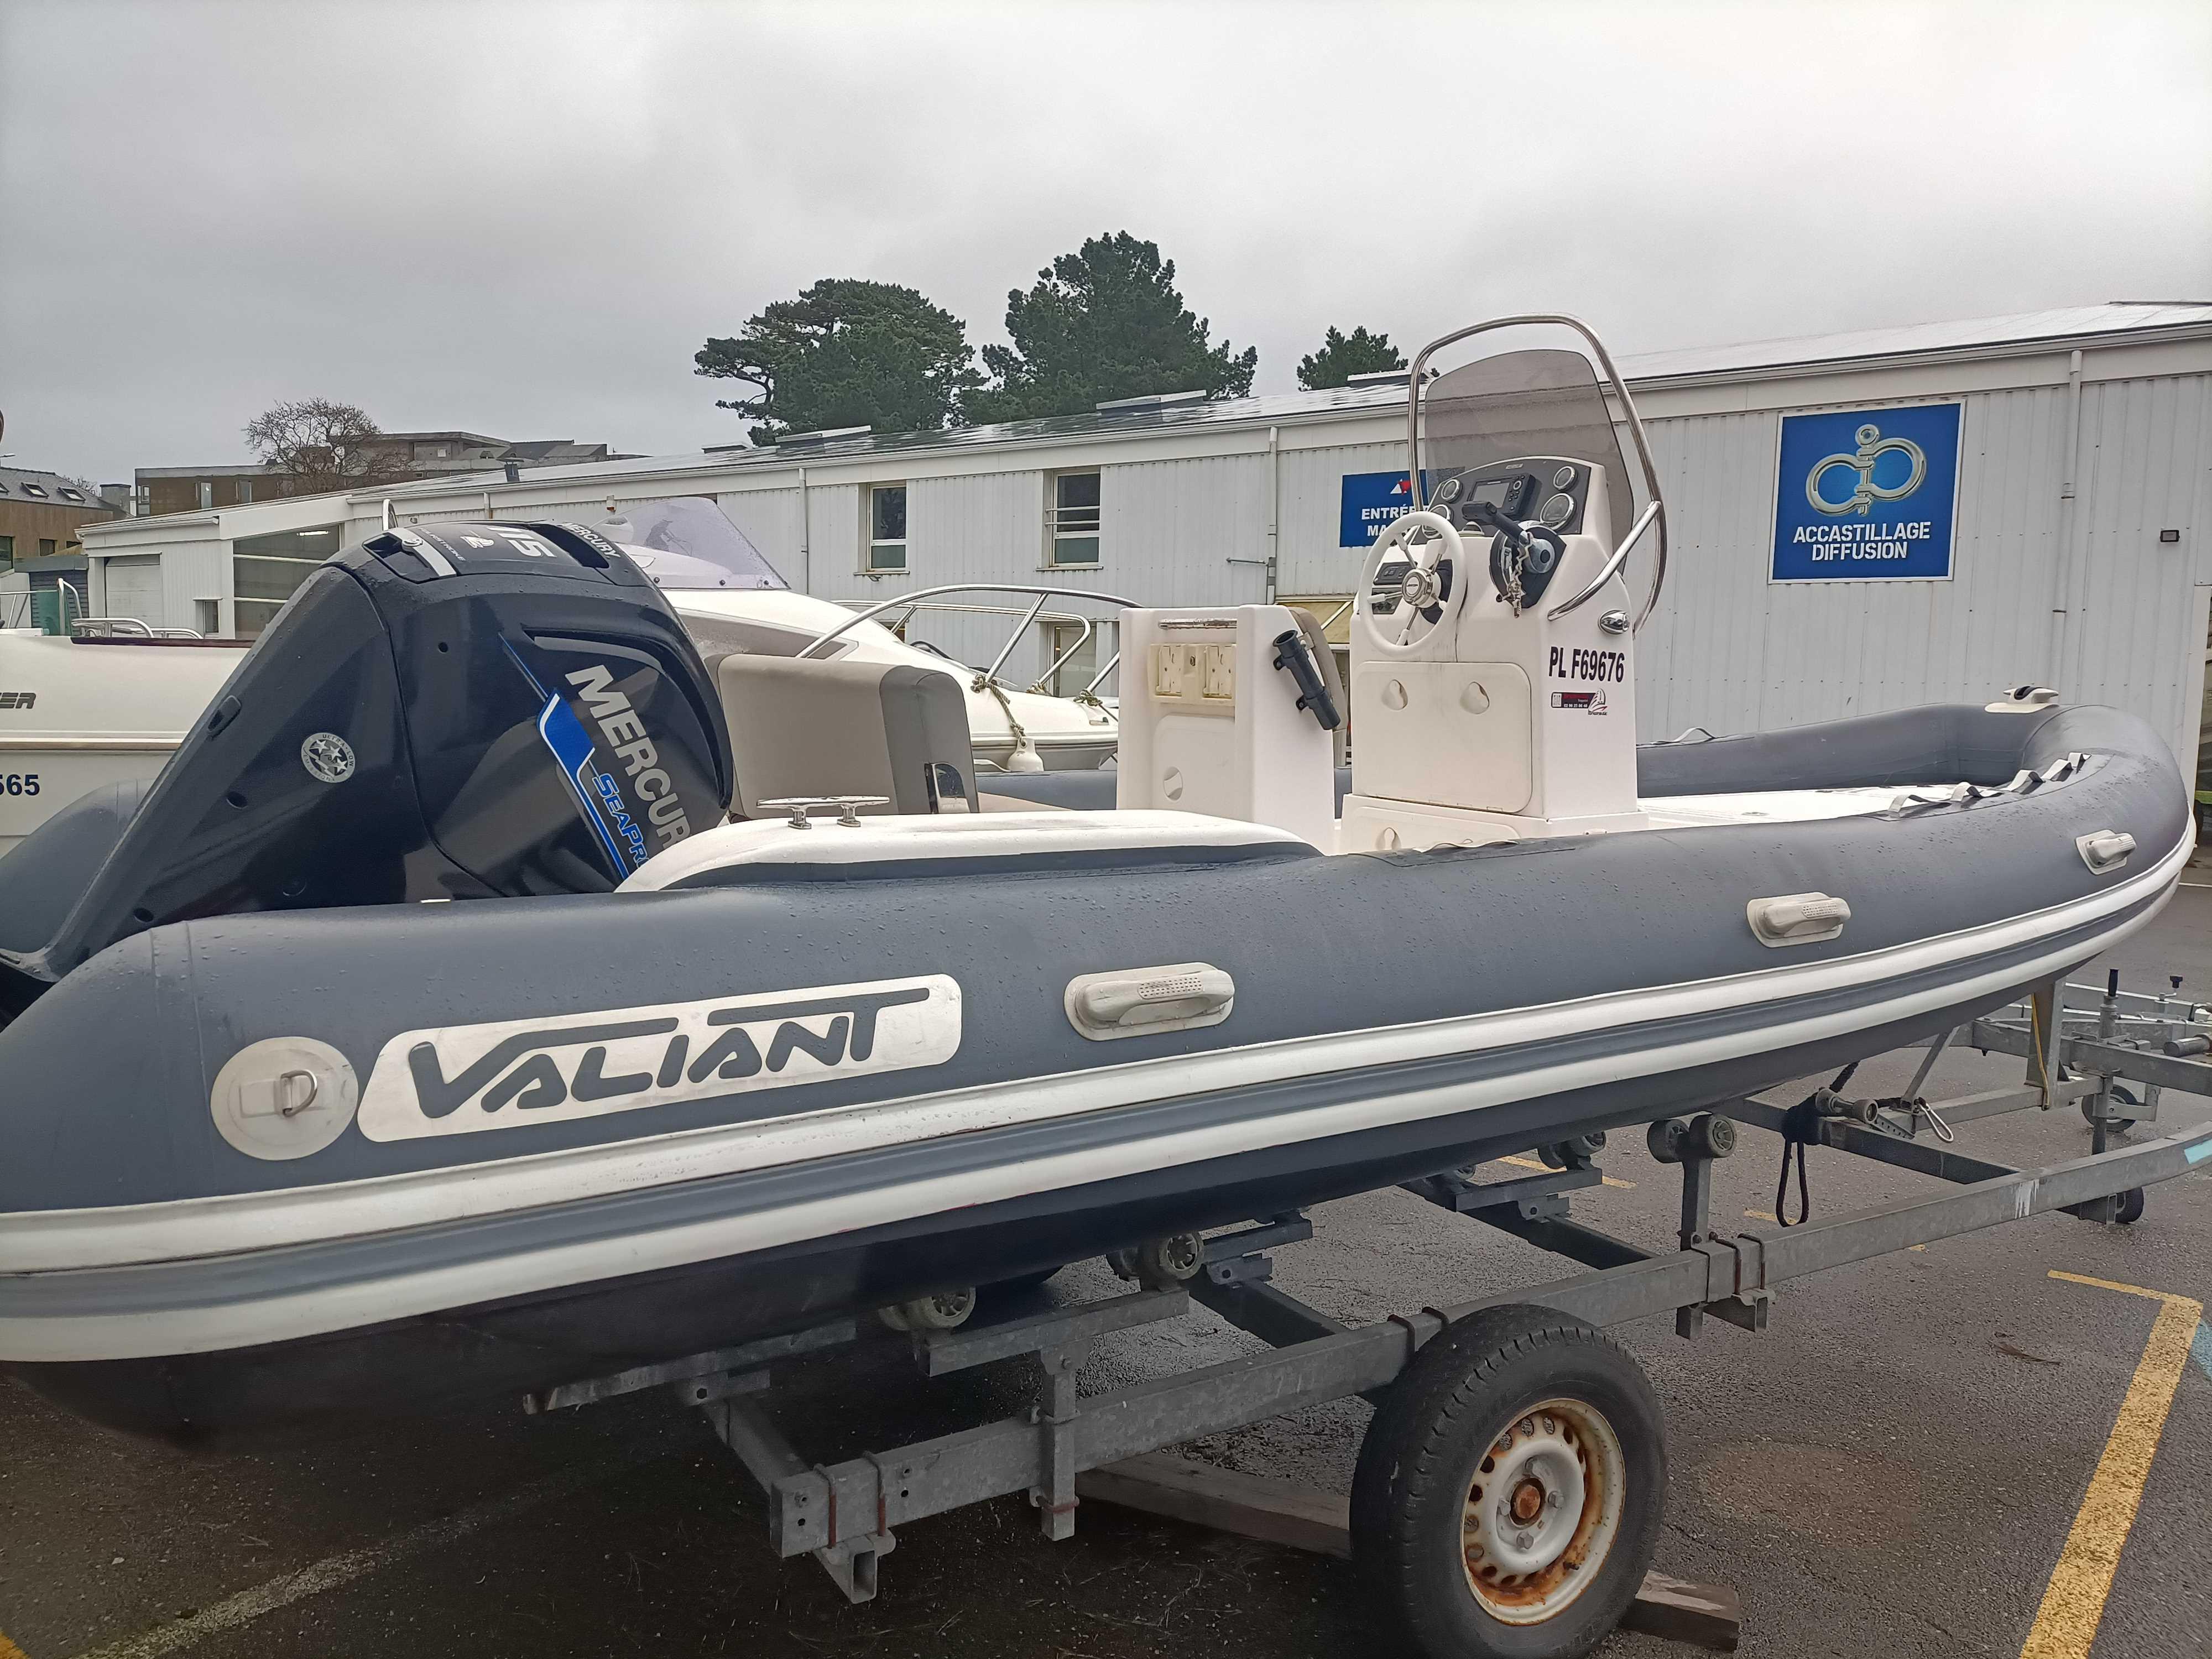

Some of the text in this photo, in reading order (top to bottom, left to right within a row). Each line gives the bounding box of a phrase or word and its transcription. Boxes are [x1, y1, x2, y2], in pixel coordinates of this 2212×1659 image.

[560, 522, 621, 558] MERCURY
[1367, 525, 1387, 536] MA
[1793, 521, 1932, 544] ACCASTILLAGE
[1812, 541, 1907, 561] DIFFUSION
[1549, 646, 1625, 682] PL F69676
[0, 692, 36, 709] ER
[565, 665, 691, 849] MERCUR
[0, 774, 40, 796] 65
[408, 988, 930, 1118] VALIANT
